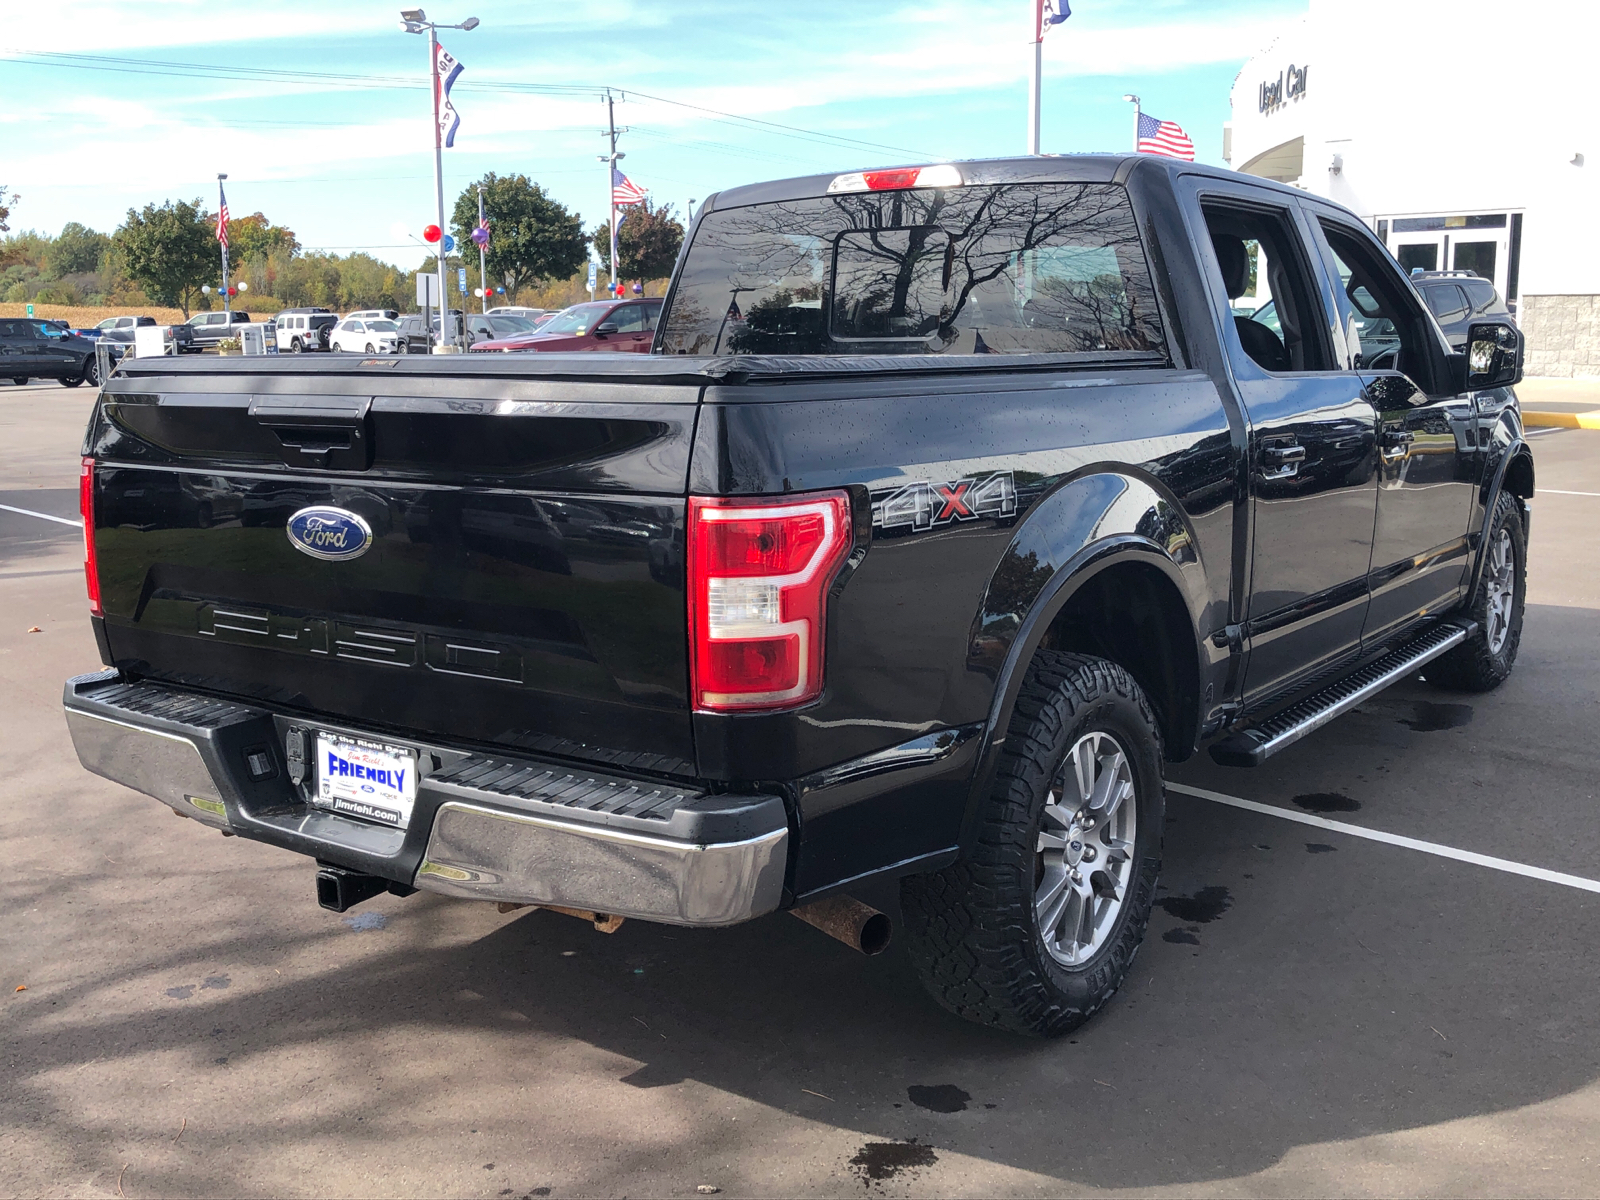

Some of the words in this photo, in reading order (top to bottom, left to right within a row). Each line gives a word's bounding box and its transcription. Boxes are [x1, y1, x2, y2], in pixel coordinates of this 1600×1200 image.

[1259, 70, 1283, 113] Used
[1286, 64, 1308, 98] Car
[303, 516, 348, 548] Ford
[197, 601, 525, 685] F-150
[319, 731, 337, 741] Get
[338, 735, 355, 744] the
[357, 740, 383, 750] Riehl
[385, 745, 408, 755] Deal
[328, 751, 405, 793] FRIENDLY
[334, 798, 397, 821] jimriehl.com
